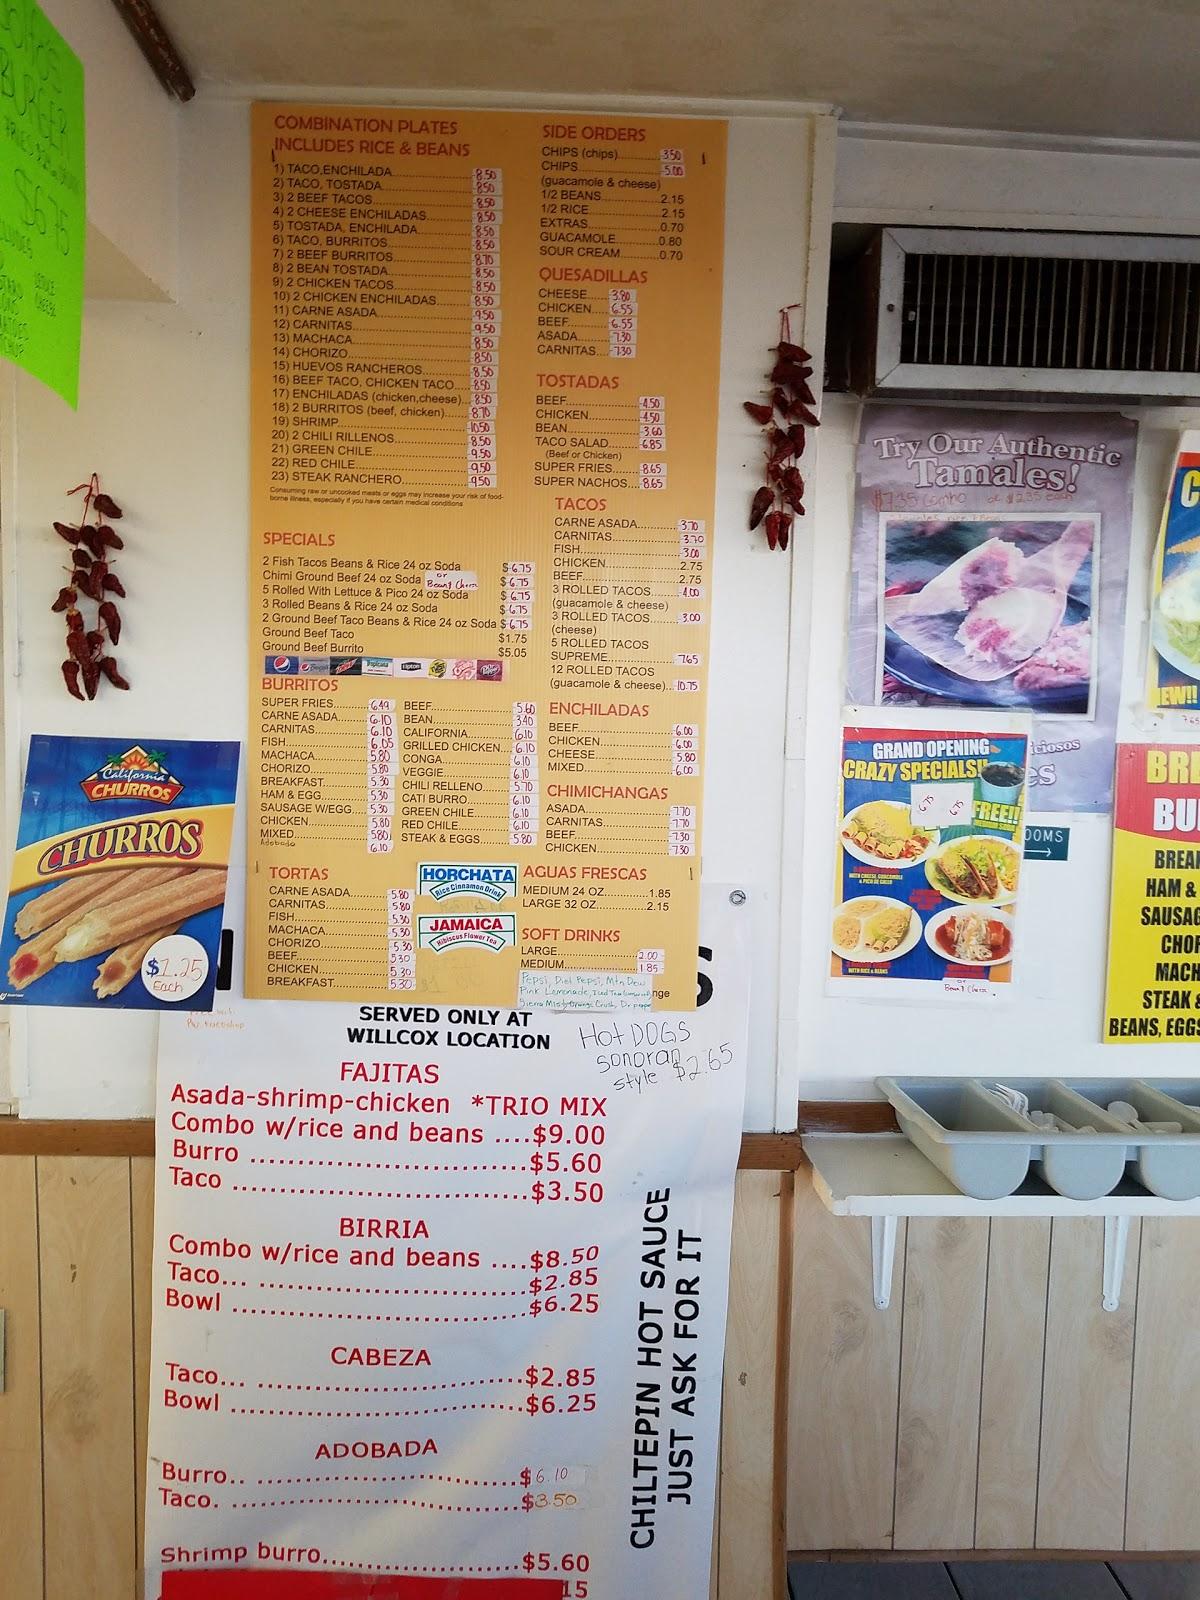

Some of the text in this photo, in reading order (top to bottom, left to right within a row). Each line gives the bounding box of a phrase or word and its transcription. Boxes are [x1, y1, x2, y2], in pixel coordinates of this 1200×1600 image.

[275, 115, 458, 135] COMBINATION PLATES
[543, 125, 647, 142] SIDE ORDERS
[275, 138, 470, 157] INCLUDES RICE & BEANS
[288, 207, 294, 217] 2
[298, 208, 346, 218] CHEESE
[350, 210, 426, 221] ENCHILADAS
[540, 246, 620, 258] SOUR CREAM
[539, 267, 648, 284] QUESADILLAS
[536, 374, 620, 390] TOSTADAS
[536, 436, 609, 448] TACO SALAD
[873, 432, 1122, 466] Try Our Authentic
[907, 457, 1081, 493] Tamales!
[555, 497, 607, 512] TACOS
[264, 532, 336, 546] SPECIALS
[262, 556, 461, 571] 2 Fish Tacos Beans & Rice 24 oz Soda
[262, 626, 528, 644] Ground Beef Taco $1.75
[262, 640, 527, 658] Ground Beef Burrito $5.05
[551, 664, 655, 676] 12 ROLLED TACOS
[262, 677, 338, 692] BURRITOS
[1153, 685, 1198, 705] EW!!
[550, 702, 650, 717] ENCHILADAS
[403, 740, 449, 752] GRILLED
[452, 742, 501, 753] CHICKEN
[872, 738, 990, 760] GRAND OPENING
[102, 765, 167, 783] California
[843, 758, 898, 782] CRAZY
[91, 782, 172, 801] CHURROS
[547, 784, 668, 800] CHIMICHANGAS
[974, 800, 1022, 824] FREE!!
[1152, 798, 1200, 832] BU
[37, 818, 204, 875] CHURROS
[269, 866, 328, 881] TORTAS
[423, 868, 514, 881] HORCHATA
[524, 865, 648, 881] AGUAS FRESCAS
[434, 883, 502, 898] Rice Cinnamon Drink
[522, 885, 569, 896] MEDIUM
[572, 886, 584, 896] 24
[649, 888, 670, 898] 1.85
[1146, 878, 1196, 898] HAM &
[522, 898, 562, 909] LARGE
[564, 900, 577, 909] 32
[646, 902, 670, 912] 2.15
[430, 918, 503, 932] JAMAICA
[521, 928, 620, 942] SOFT DRINKS
[436, 932, 498, 946] Hibiscus Flower Tea
[152, 980, 183, 992] Each
[1142, 990, 1190, 1010] STEAK
[359, 1006, 532, 1027] SERVED ONLY AT
[578, 1020, 691, 1049] Hot DOGS
[1108, 1017, 1162, 1038] BEANS,
[346, 1027, 550, 1050] WILLCOX LOCATION
[672, 1042, 734, 1082] $2.65
[340, 1061, 440, 1084] FAJITAS
[170, 1083, 450, 1114] Asada-shrimp-chicken
[560, 1096, 608, 1117] MIX
[171, 1112, 606, 1148] Combo w/rice and beans $9.00
[173, 1138, 602, 1176] Burro $5.60
[168, 1166, 604, 1204] Taco $3.50
[338, 1218, 430, 1239] BIRRIA
[168, 1234, 599, 1273] Combo w/rice and beans $8.50
[167, 1261, 599, 1296] Taco $2.85
[166, 1288, 599, 1318] Bowl $6.25
[330, 1346, 432, 1366] CABEZA
[165, 1362, 596, 1389] Taco $2.85
[630, 1186, 671, 1550] CHILTEPIN HOT SAUCE
[667, 1228, 702, 1505] JUST ASK FOR IT
[164, 1388, 596, 1416] Bowl $6.25
[314, 1438, 438, 1460] ADOBADA
[162, 1462, 228, 1485] Burro
[158, 1487, 212, 1509] Taco
[160, 1541, 590, 1574] Shrimp burro $5.60
